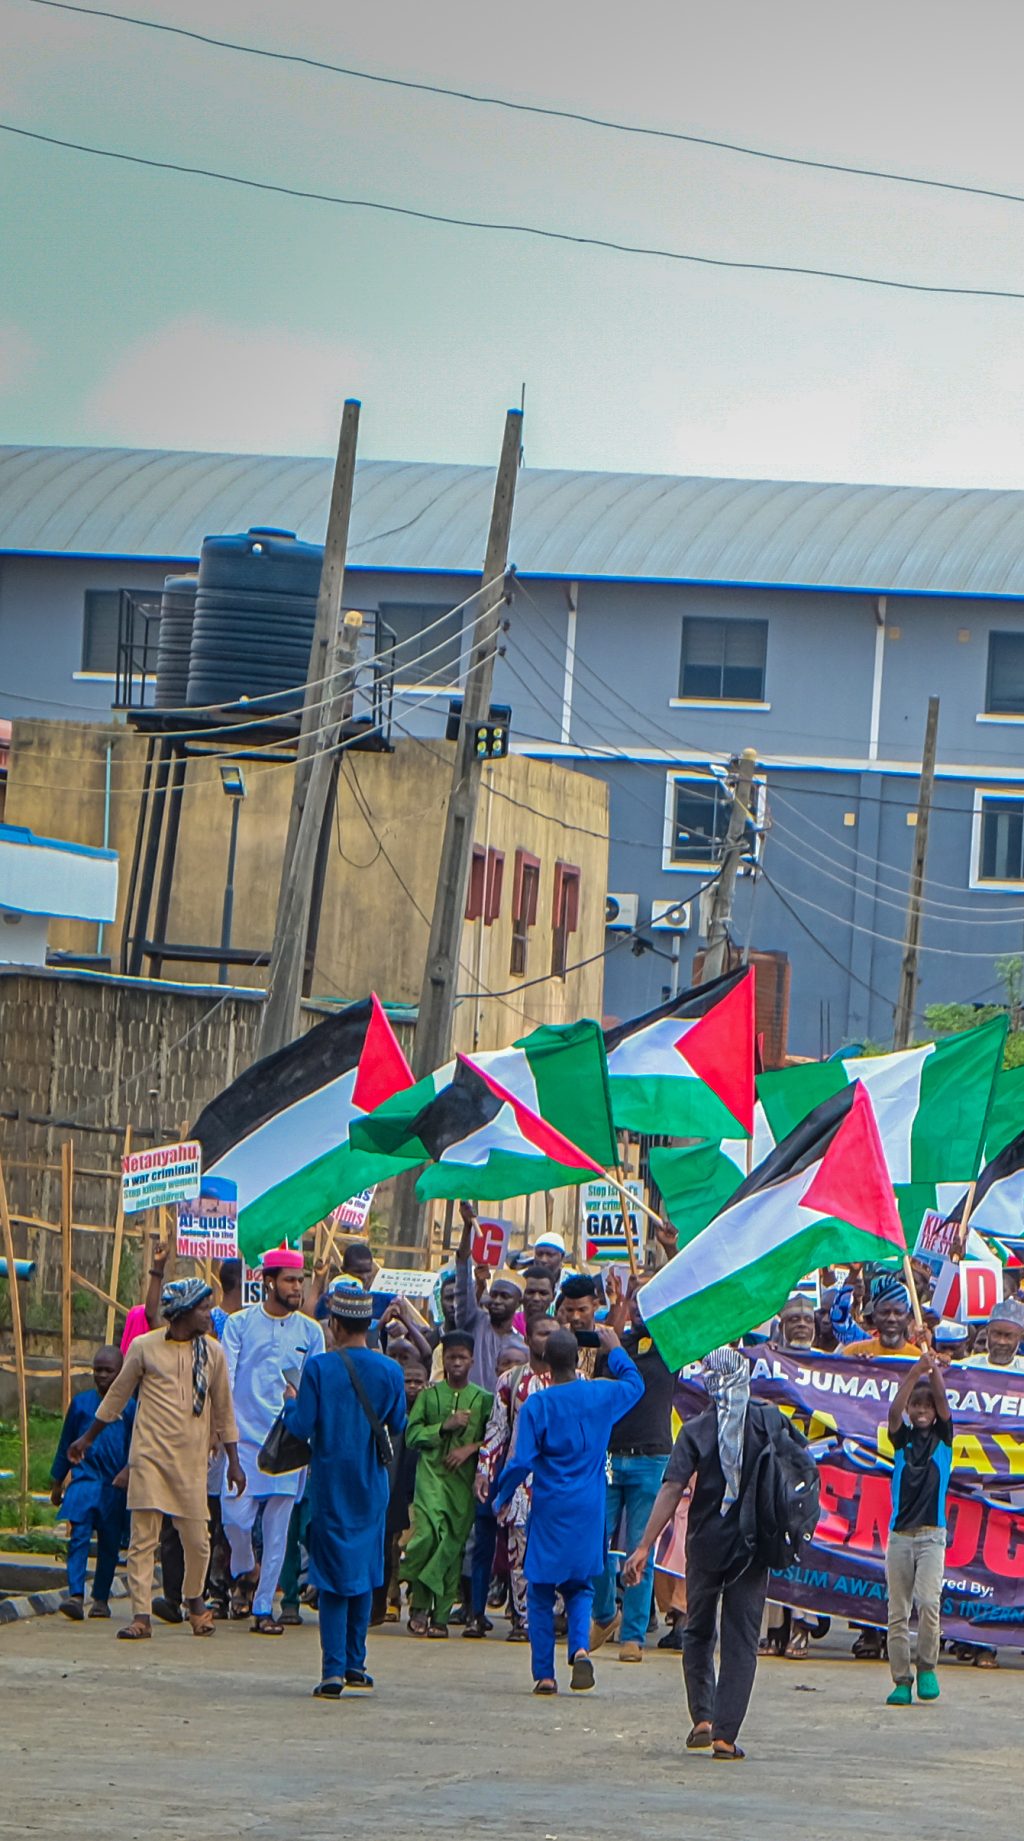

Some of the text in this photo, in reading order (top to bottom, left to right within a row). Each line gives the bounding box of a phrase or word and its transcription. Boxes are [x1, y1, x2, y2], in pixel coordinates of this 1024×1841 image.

[131, 1174, 149, 1186] war
[586, 1213, 638, 1236] GAZA
[178, 1240, 236, 1257] Muslims
[471, 1223, 504, 1266] G
[965, 1268, 997, 1317] D
